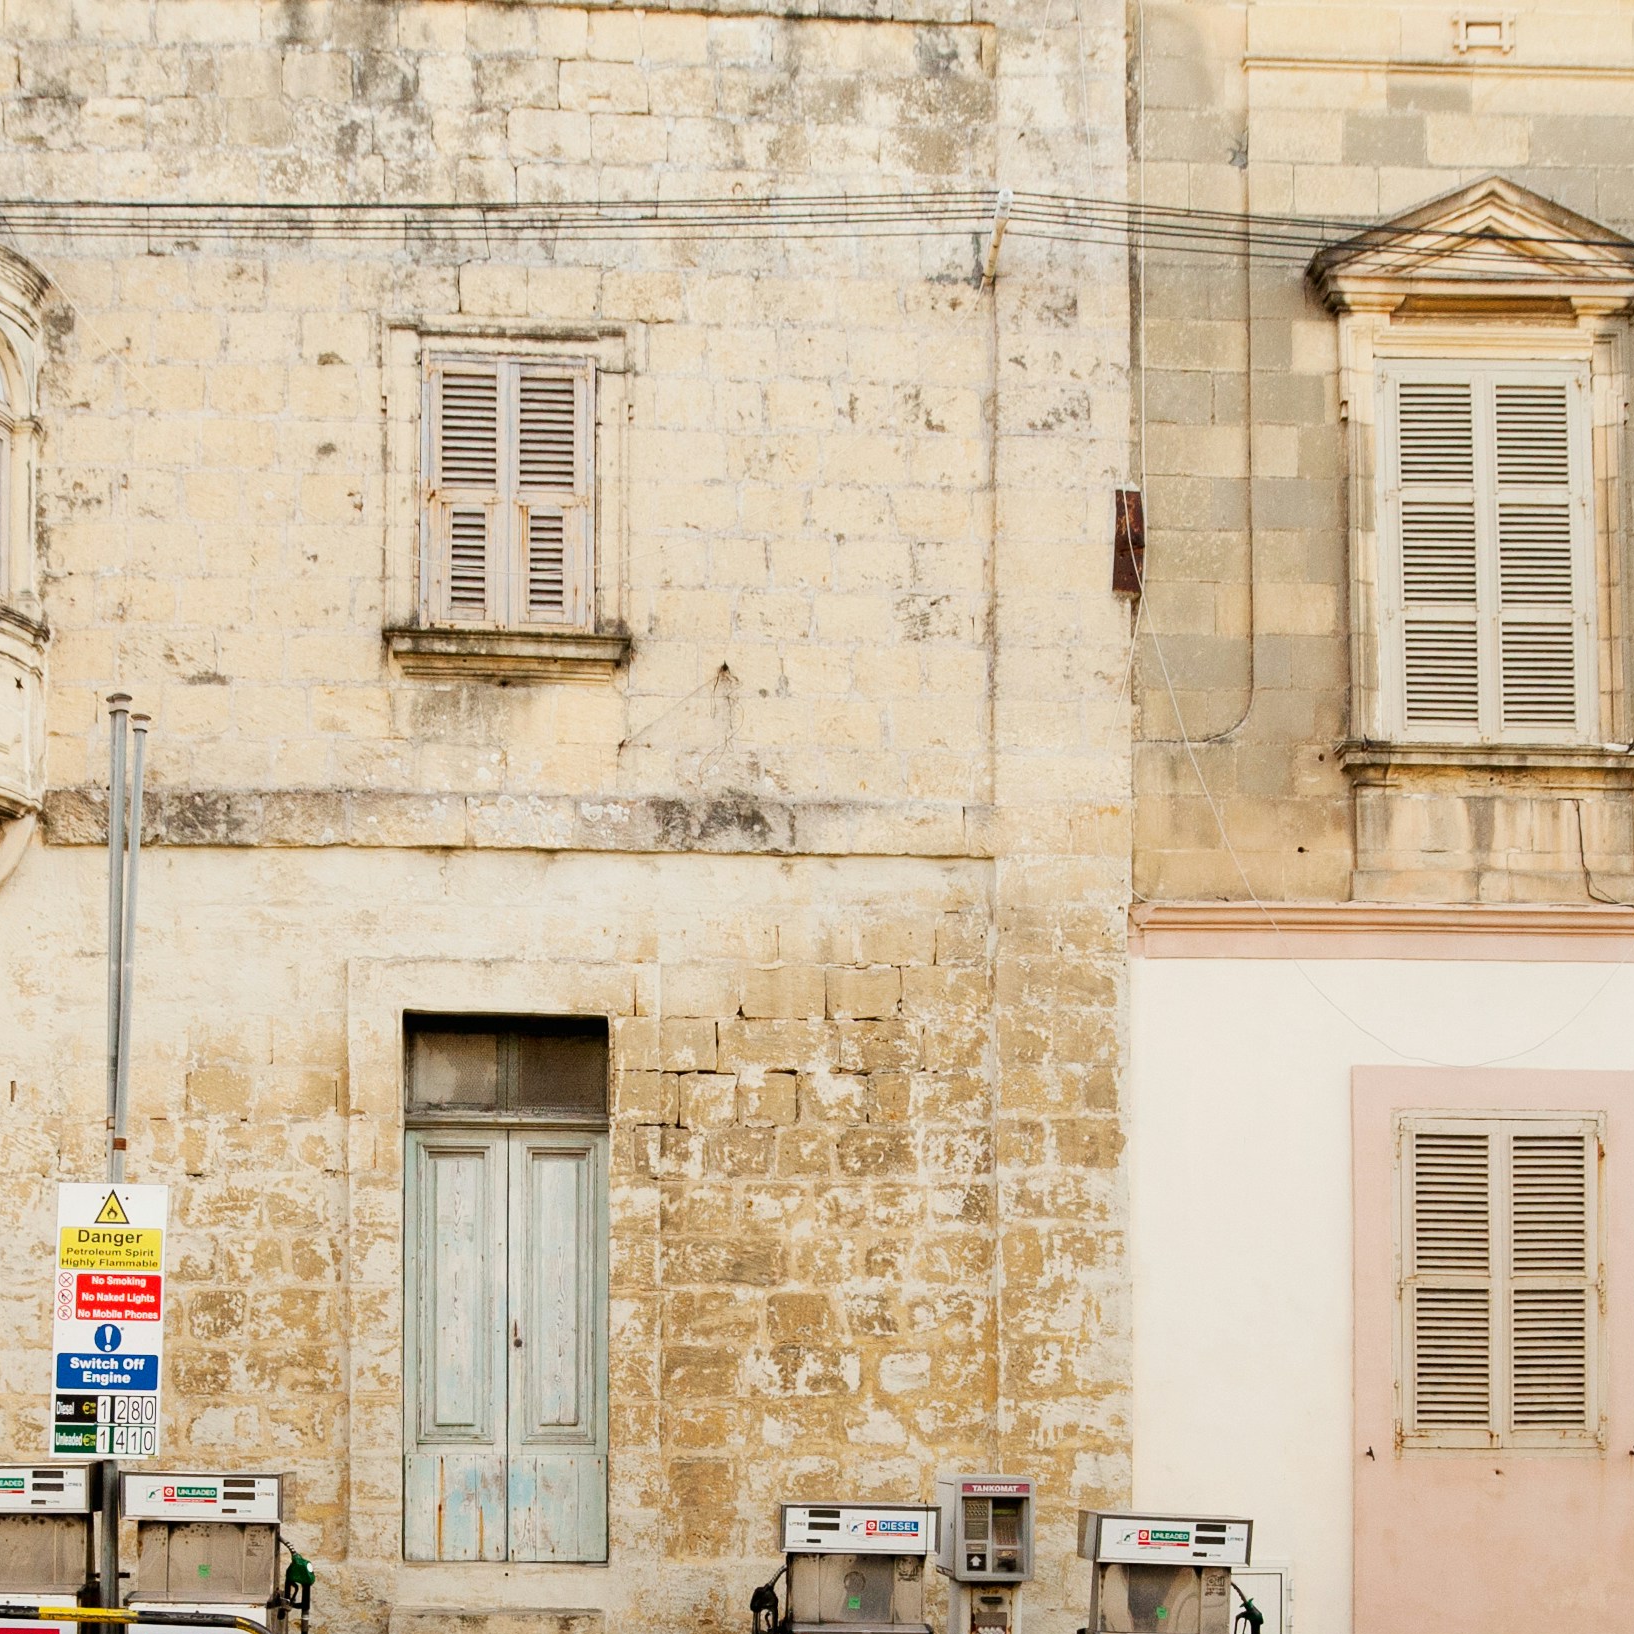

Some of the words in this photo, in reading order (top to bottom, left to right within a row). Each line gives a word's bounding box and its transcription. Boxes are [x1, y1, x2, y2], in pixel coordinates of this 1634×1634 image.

[77, 1229, 143, 1247] Danger
[66, 1247, 122, 1256] Petroleum
[125, 1248, 154, 1258] Spirit
[61, 1258, 96, 1267] Highly
[99, 1258, 158, 1268] Flammable
[91, 1276, 105, 1285] No
[106, 1276, 147, 1288] Smoking
[81, 1292, 95, 1301] No
[96, 1292, 125, 1302] Naked
[127, 1293, 156, 1304] Lights
[77, 1309, 91, 1318] No
[92, 1309, 123, 1319] Mobile
[124, 1310, 159, 1319] Phones
[69, 1356, 119, 1370] Switch
[122, 1358, 145, 1370] Off
[82, 1370, 131, 1386] Engine
[56, 1401, 75, 1415] Diesel
[55, 1432, 83, 1446] Unleaded
[177, 1488, 216, 1496] UNLEADED
[879, 1521, 917, 1531] DIESEL
[1151, 1531, 1189, 1540] UNLEADED
